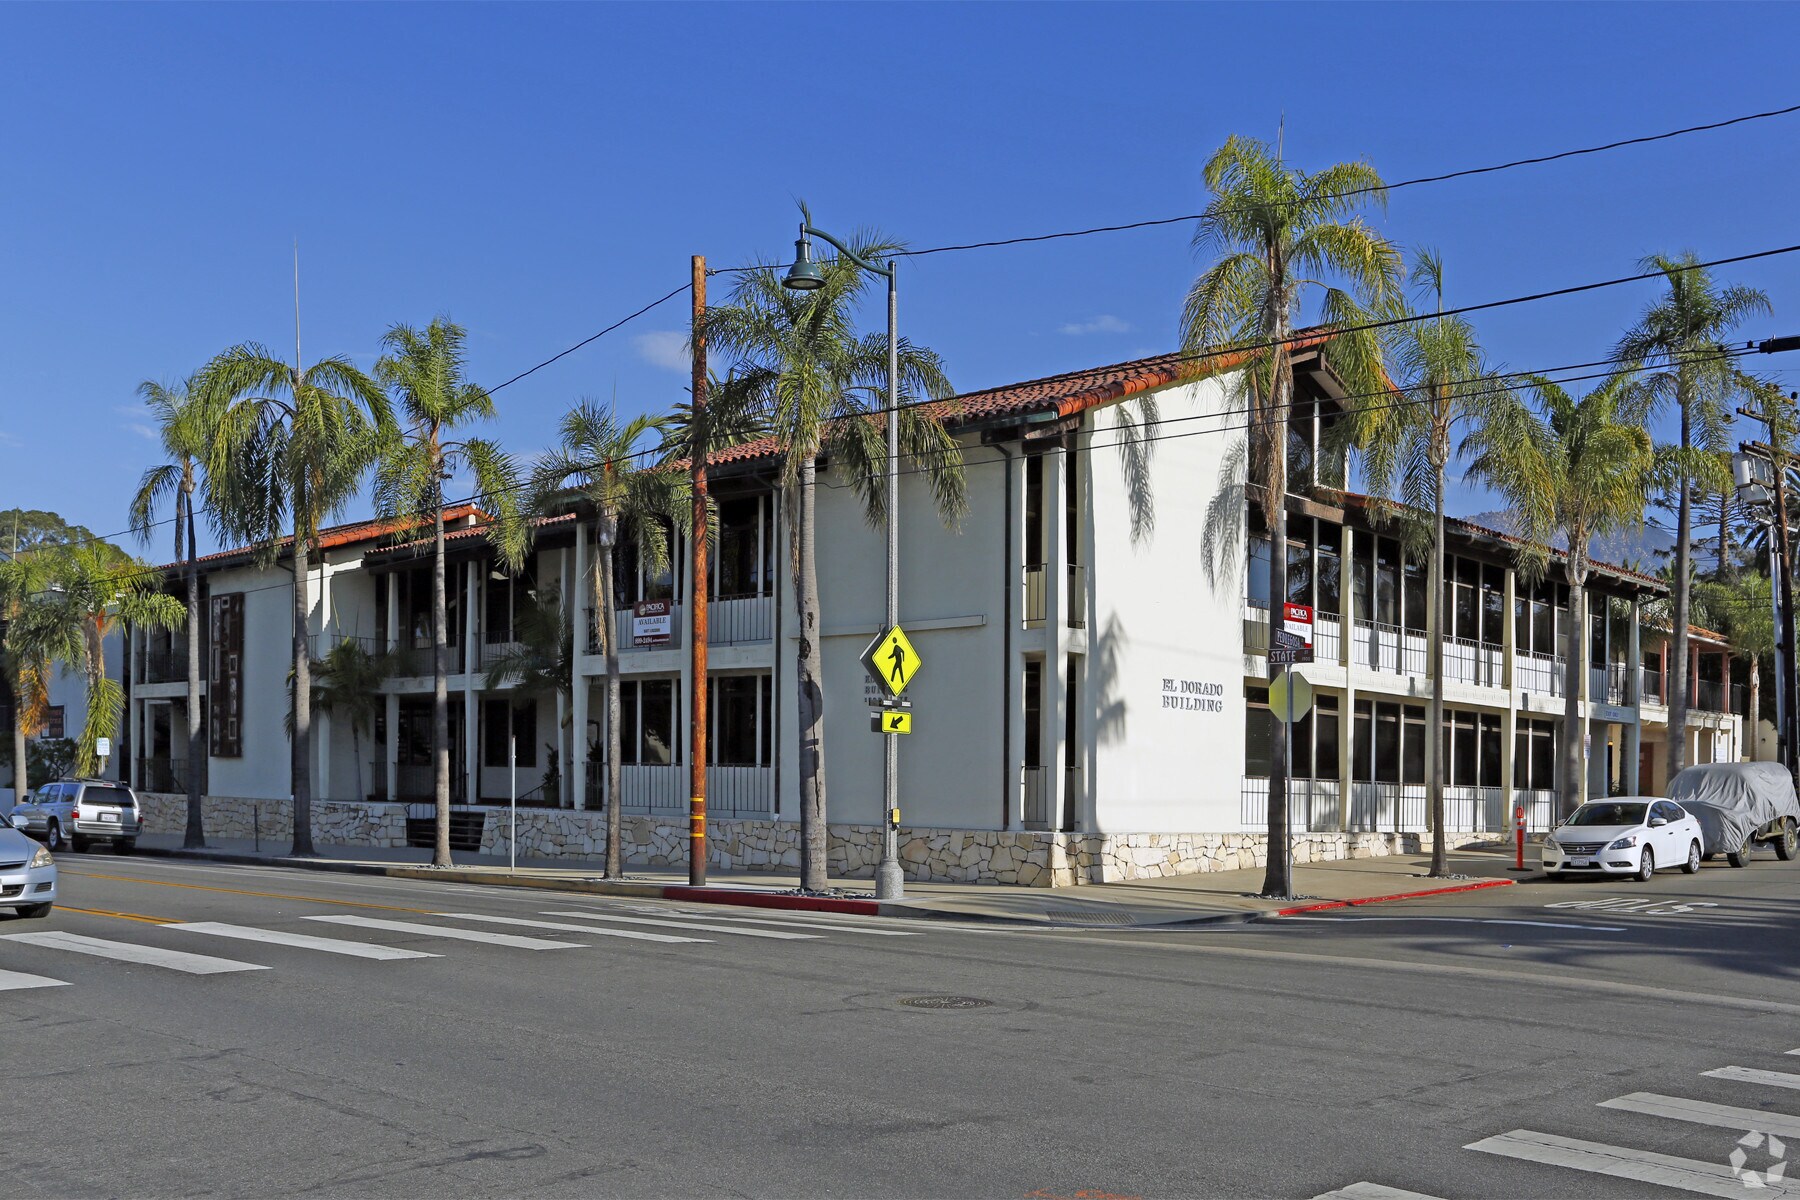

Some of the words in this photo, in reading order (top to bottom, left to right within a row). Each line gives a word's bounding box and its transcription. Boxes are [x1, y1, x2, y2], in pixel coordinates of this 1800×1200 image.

[638, 617, 666, 626] AVAILABLE
[1270, 650, 1296, 662] STATE
[1162, 678, 1178, 692] EL
[1180, 680, 1223, 697] DORADO
[1162, 695, 1223, 713] BUILDING
